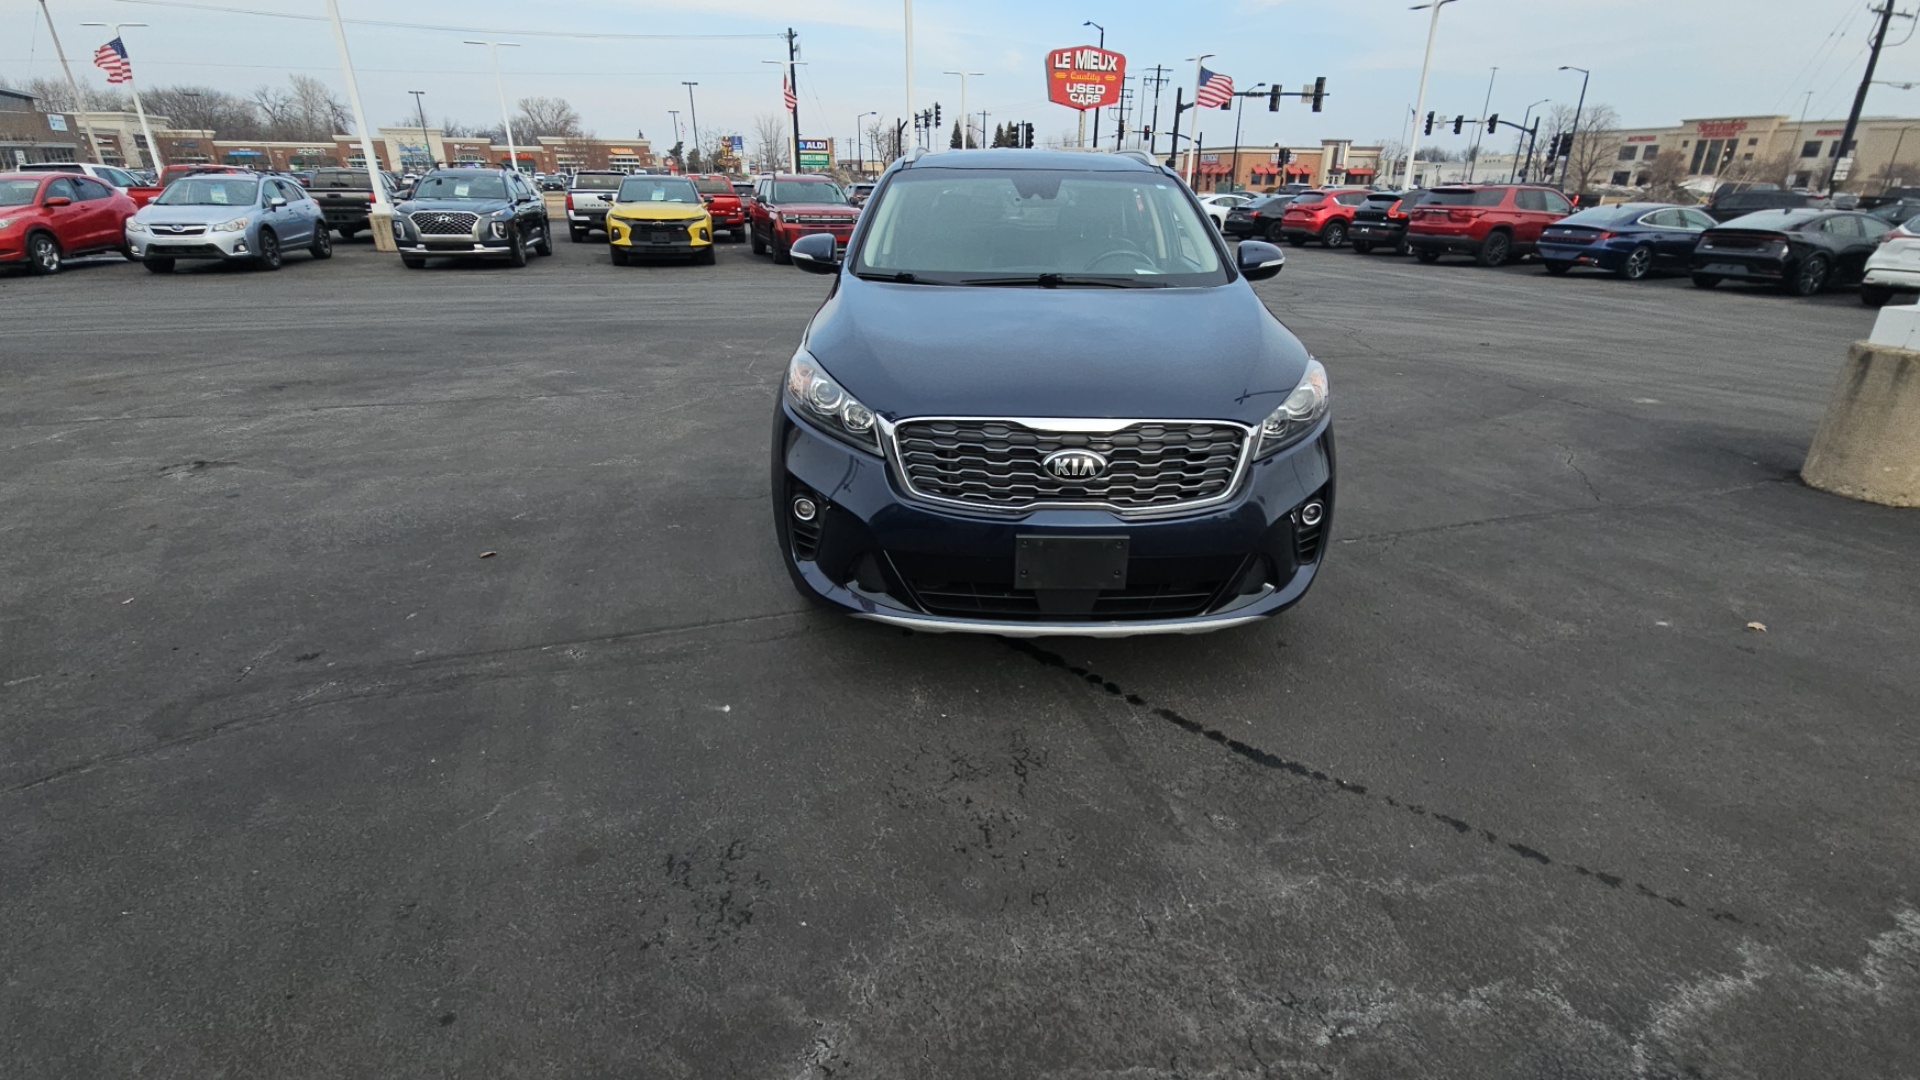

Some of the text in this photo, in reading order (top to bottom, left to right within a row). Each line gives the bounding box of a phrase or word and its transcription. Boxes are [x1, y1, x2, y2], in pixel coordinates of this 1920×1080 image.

[1055, 49, 1118, 71] LE MIEUX
[1070, 71, 1101, 83] Quality
[1066, 82, 1106, 95] USED
[1070, 93, 1101, 106] CARS
[806, 141, 826, 149] ALDI
[1054, 458, 1096, 476] KIA
